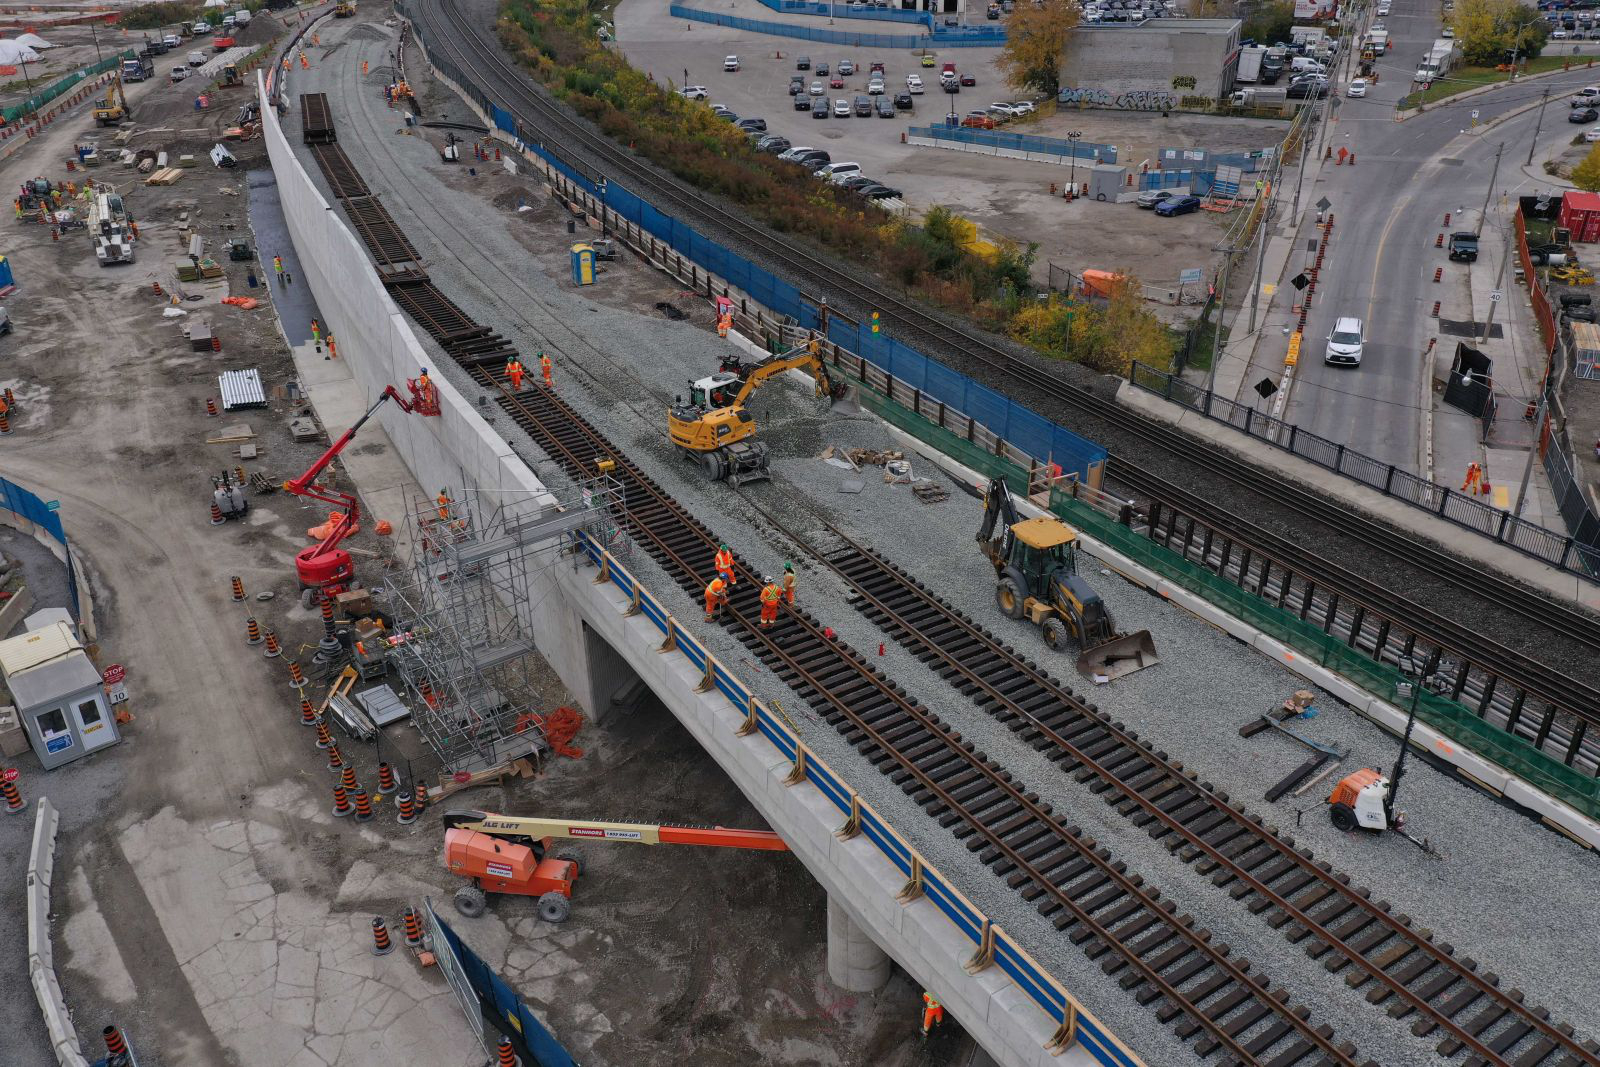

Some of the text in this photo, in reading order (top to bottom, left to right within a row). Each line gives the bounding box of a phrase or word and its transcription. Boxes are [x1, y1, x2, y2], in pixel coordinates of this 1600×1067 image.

[103, 666, 123, 678] STOP
[114, 692, 125, 702] 10
[4, 771, 18, 779] STOP
